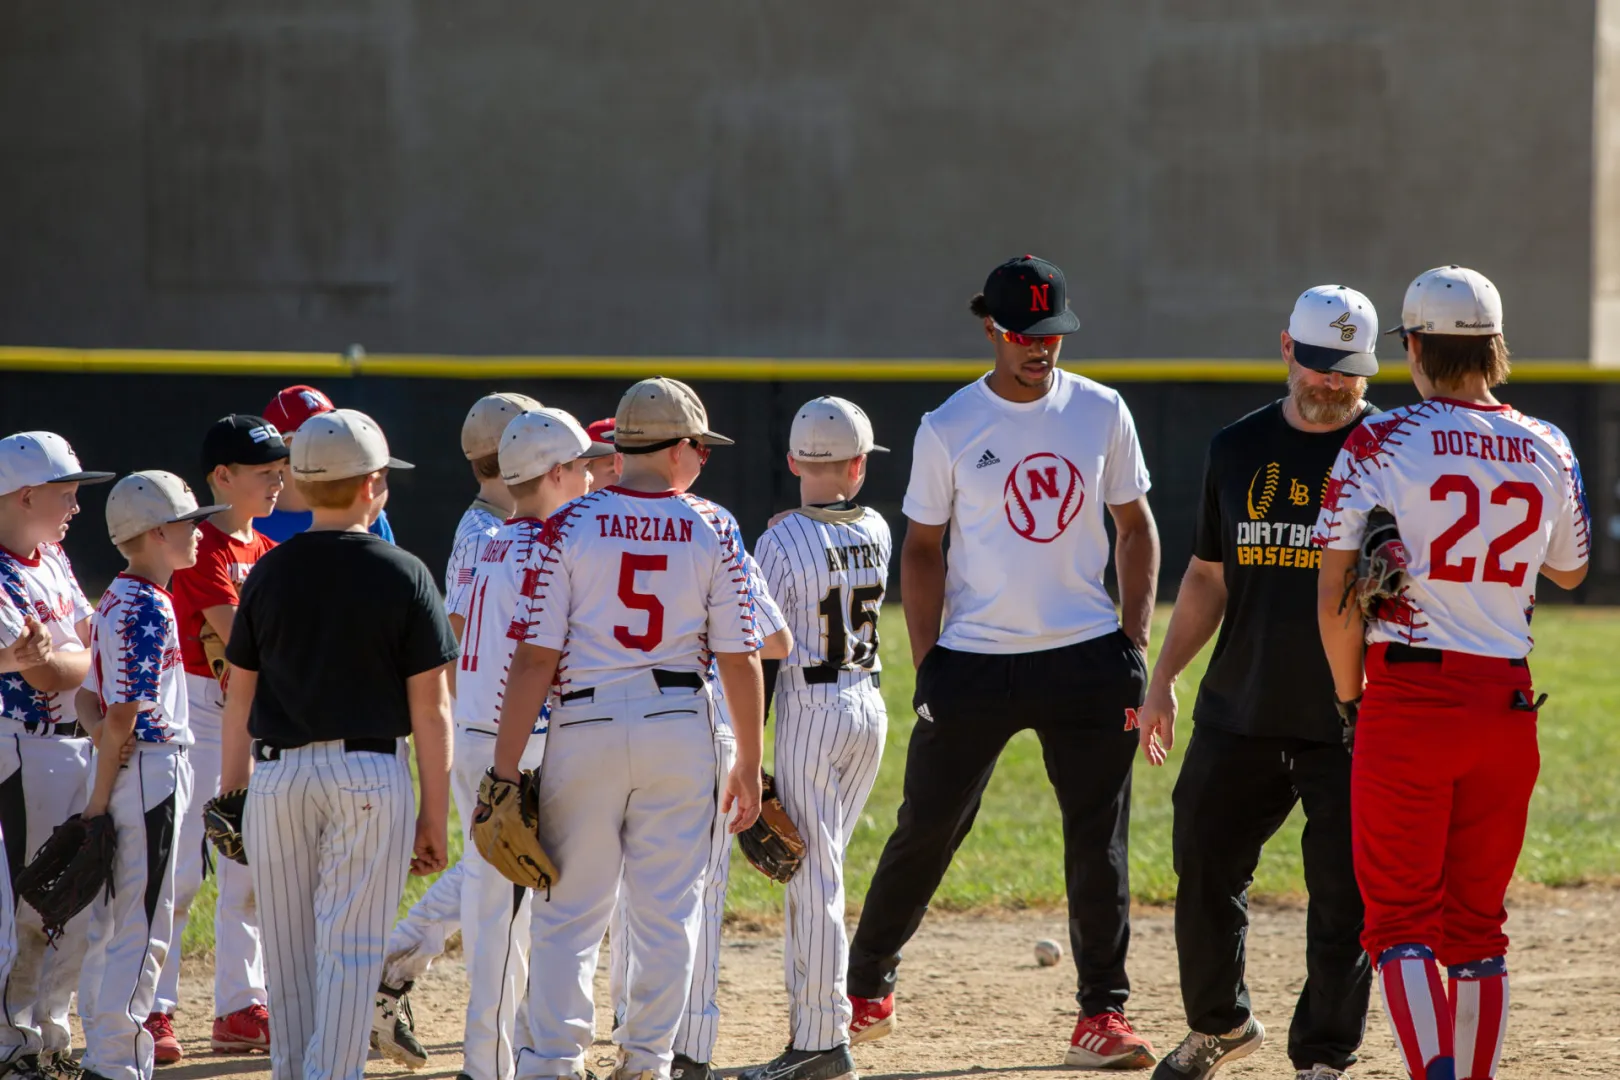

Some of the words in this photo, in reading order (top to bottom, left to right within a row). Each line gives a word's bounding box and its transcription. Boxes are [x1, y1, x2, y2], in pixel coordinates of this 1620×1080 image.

[1029, 284, 1050, 312] N
[1431, 430, 1537, 464] DOERING
[1026, 466, 1060, 501] N
[1288, 478, 1310, 506] LB
[595, 514, 694, 543] TARZIAN
[1428, 474, 1544, 588] 22
[825, 542, 882, 573] AWTRY
[614, 551, 669, 653] 5
[461, 573, 490, 672] 11
[817, 577, 885, 673] 15
